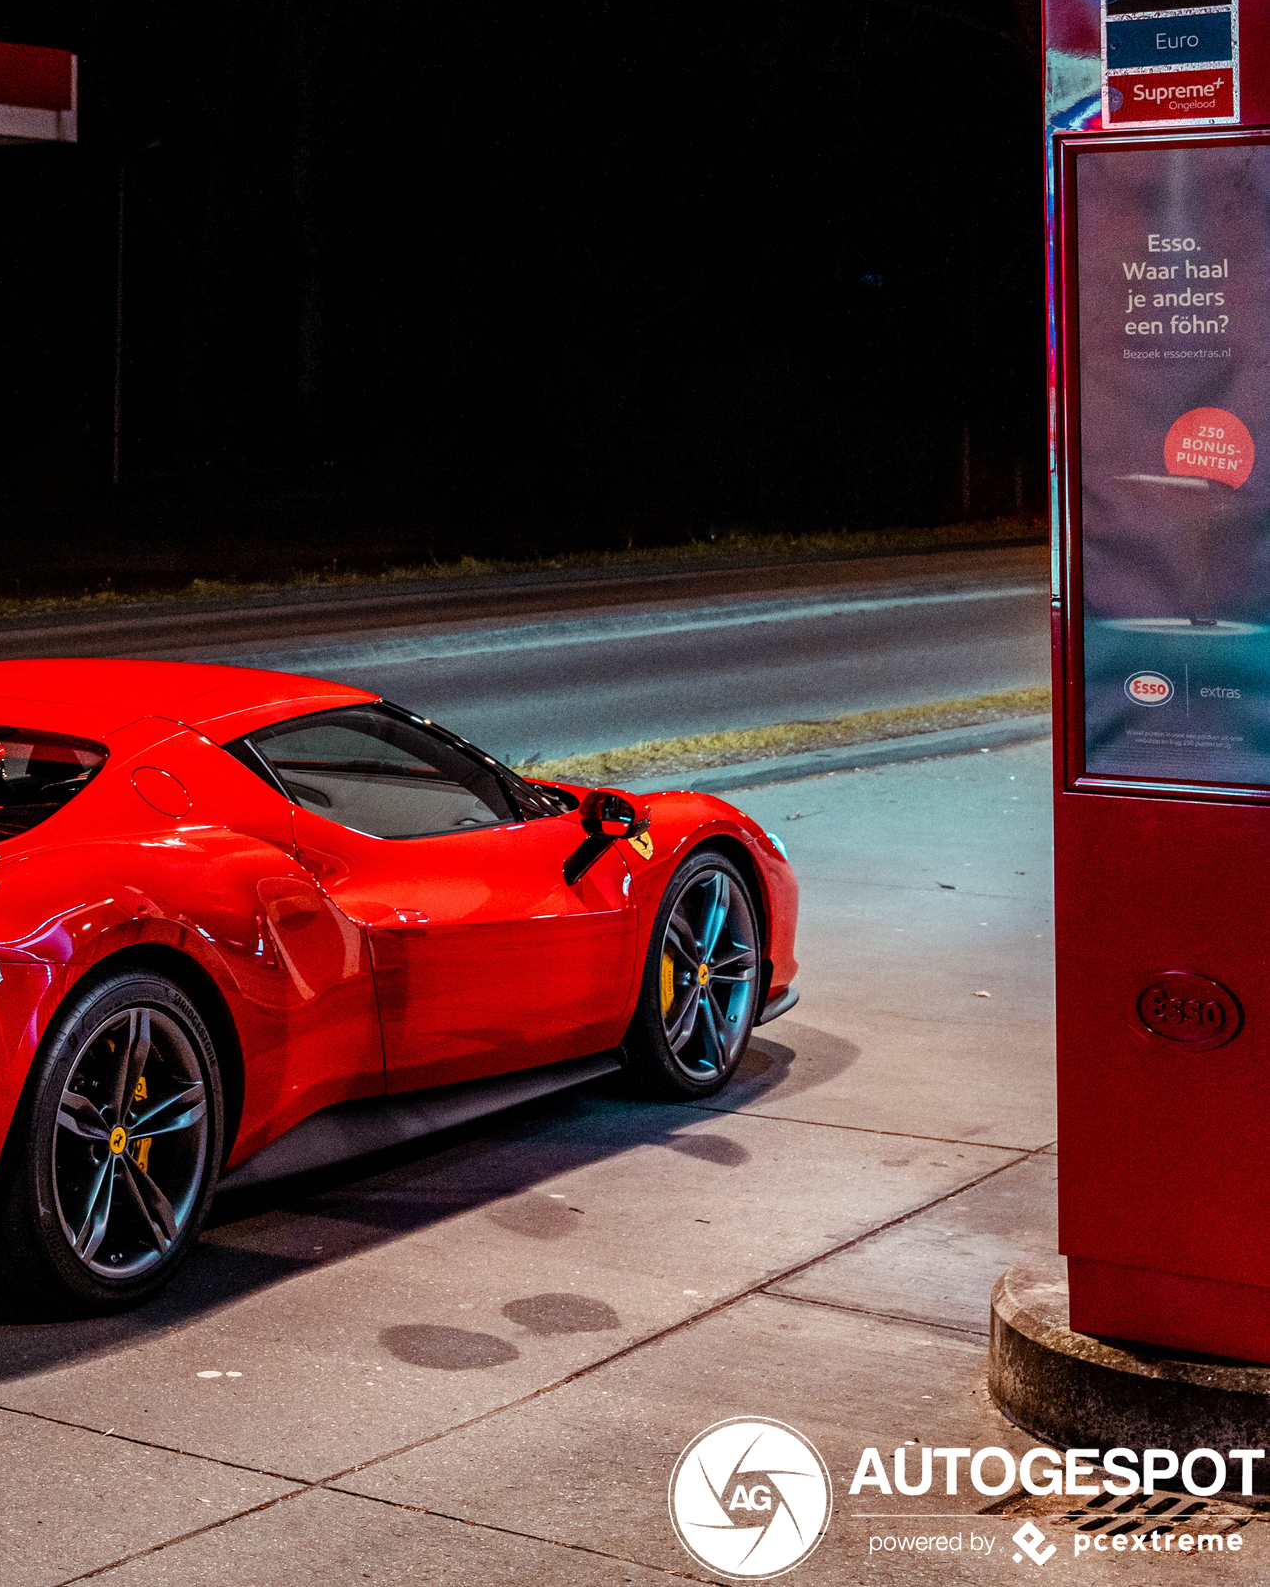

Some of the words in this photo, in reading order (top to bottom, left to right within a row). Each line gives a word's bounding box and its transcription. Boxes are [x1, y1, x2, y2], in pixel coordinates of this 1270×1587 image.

[1156, 32, 1199, 50] Euro
[1168, 98, 1216, 111] Ongelood
[1147, 234, 1201, 252] Esso.
[1122, 262, 1179, 280] Waar
[1185, 258, 1228, 278] haal
[1125, 289, 1146, 313] je
[1152, 287, 1225, 307] anders
[1124, 321, 1163, 334] een
[1170, 314, 1229, 334] föhn?
[1123, 349, 1160, 359] Bezoek
[1163, 347, 1231, 359] essoextras.nl
[1198, 425, 1225, 439] 250
[1182, 437, 1241, 455] BONUS-
[1133, 680, 1166, 695] Esso
[1200, 686, 1241, 699] extras
